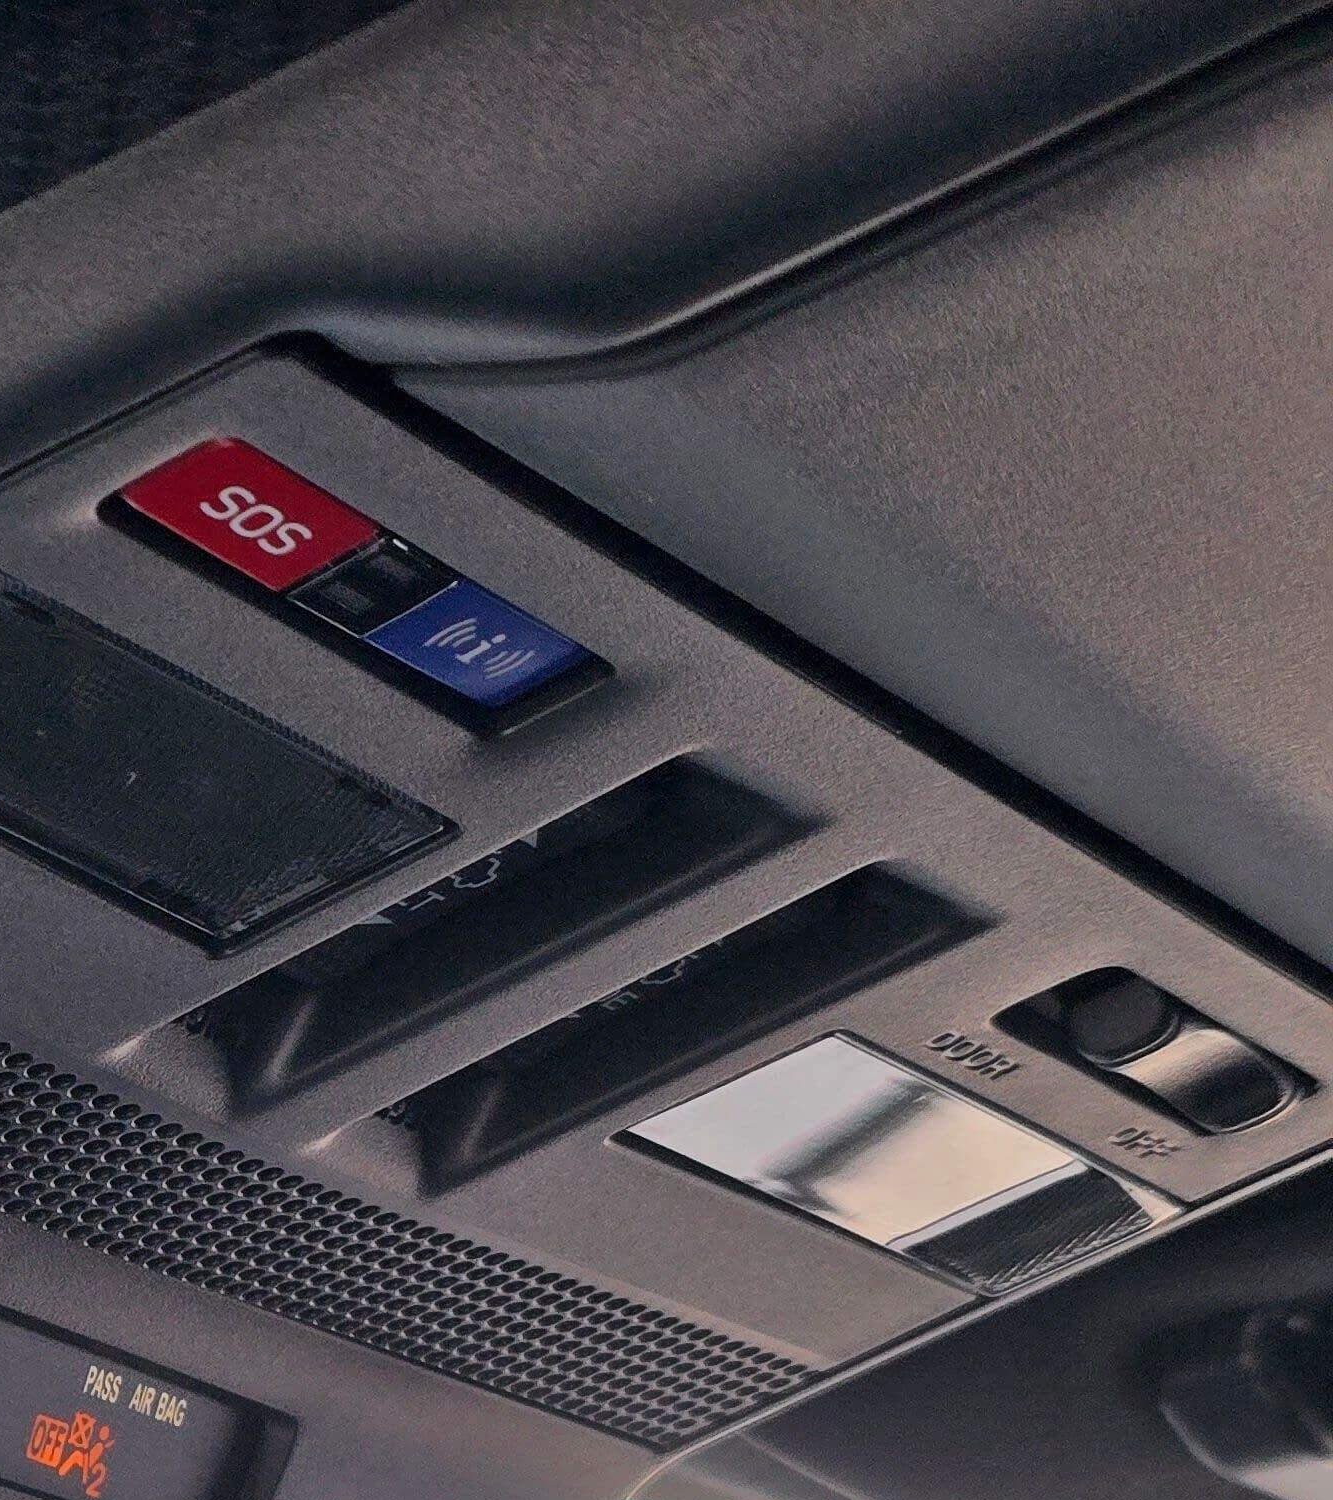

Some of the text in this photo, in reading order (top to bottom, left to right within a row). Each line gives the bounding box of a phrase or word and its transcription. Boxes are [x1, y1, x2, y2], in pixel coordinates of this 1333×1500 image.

[199, 485, 313, 556] SOS
[927, 1031, 1020, 1080] DOOR
[1107, 1126, 1179, 1160] OFF
[83, 1365, 188, 1427] PASS AIR BAG
[32, 1417, 67, 1461] OFF
